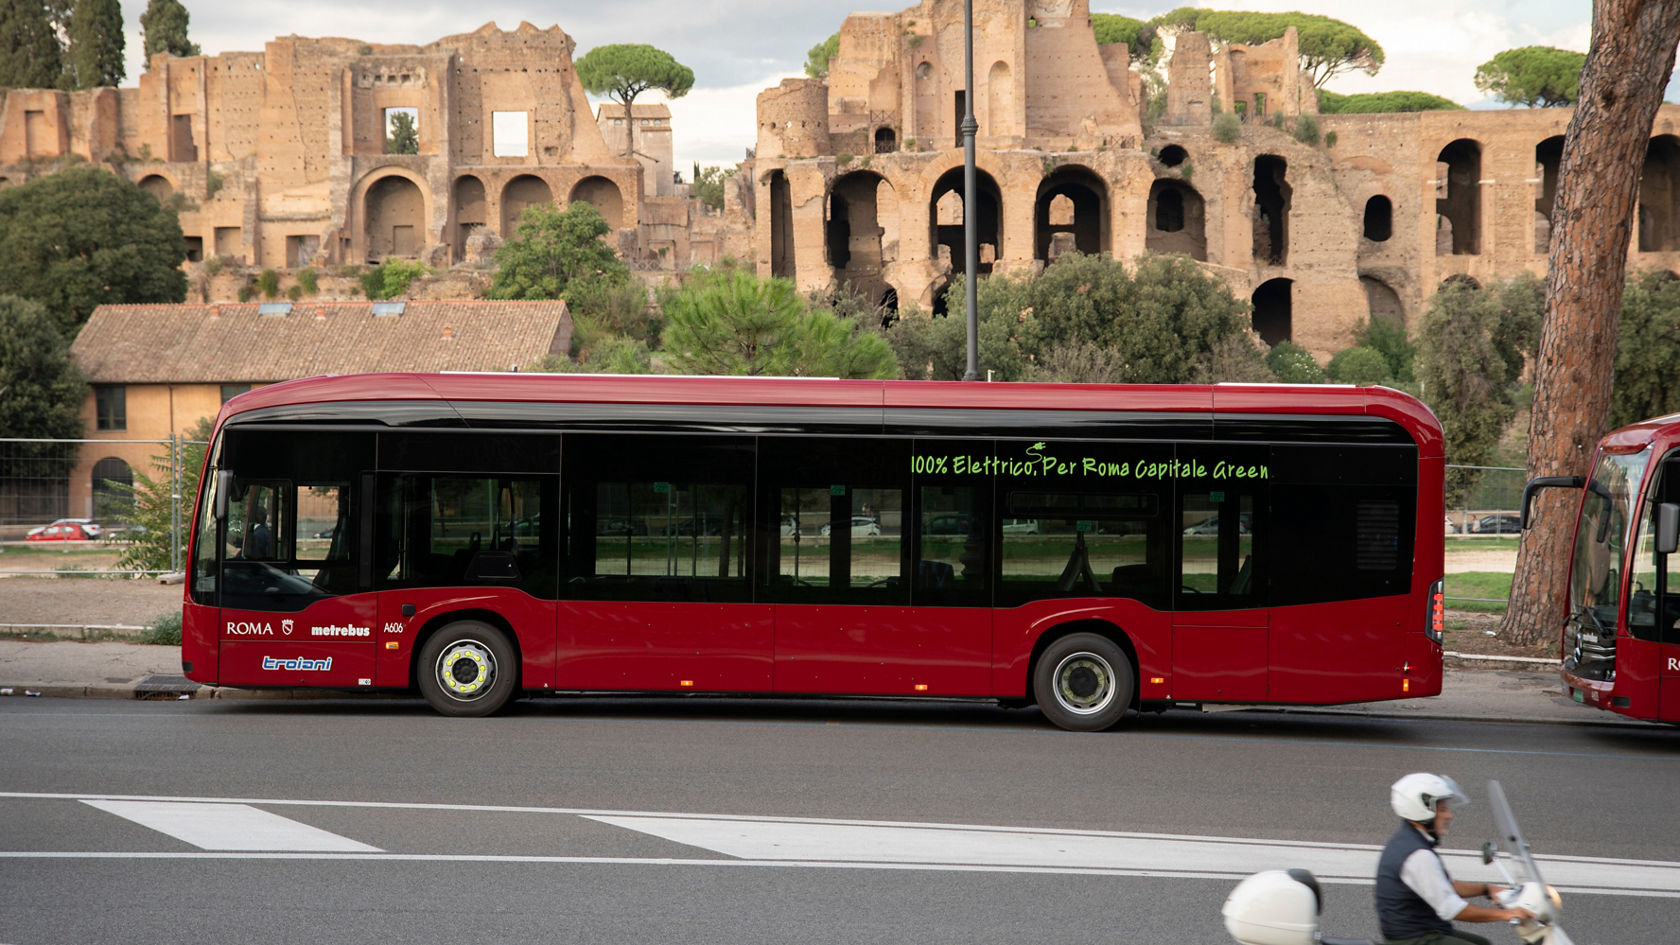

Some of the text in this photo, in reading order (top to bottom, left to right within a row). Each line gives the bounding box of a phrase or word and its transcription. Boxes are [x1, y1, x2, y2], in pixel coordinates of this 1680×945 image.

[911, 455, 1269, 480] 100% Elettrico, Per Roma Capitale Green
[226, 622, 274, 635] ROMA
[311, 625, 370, 636] metrebus
[384, 622, 403, 633] A606
[262, 656, 332, 671] troiani
[1667, 657, 1680, 671] R
